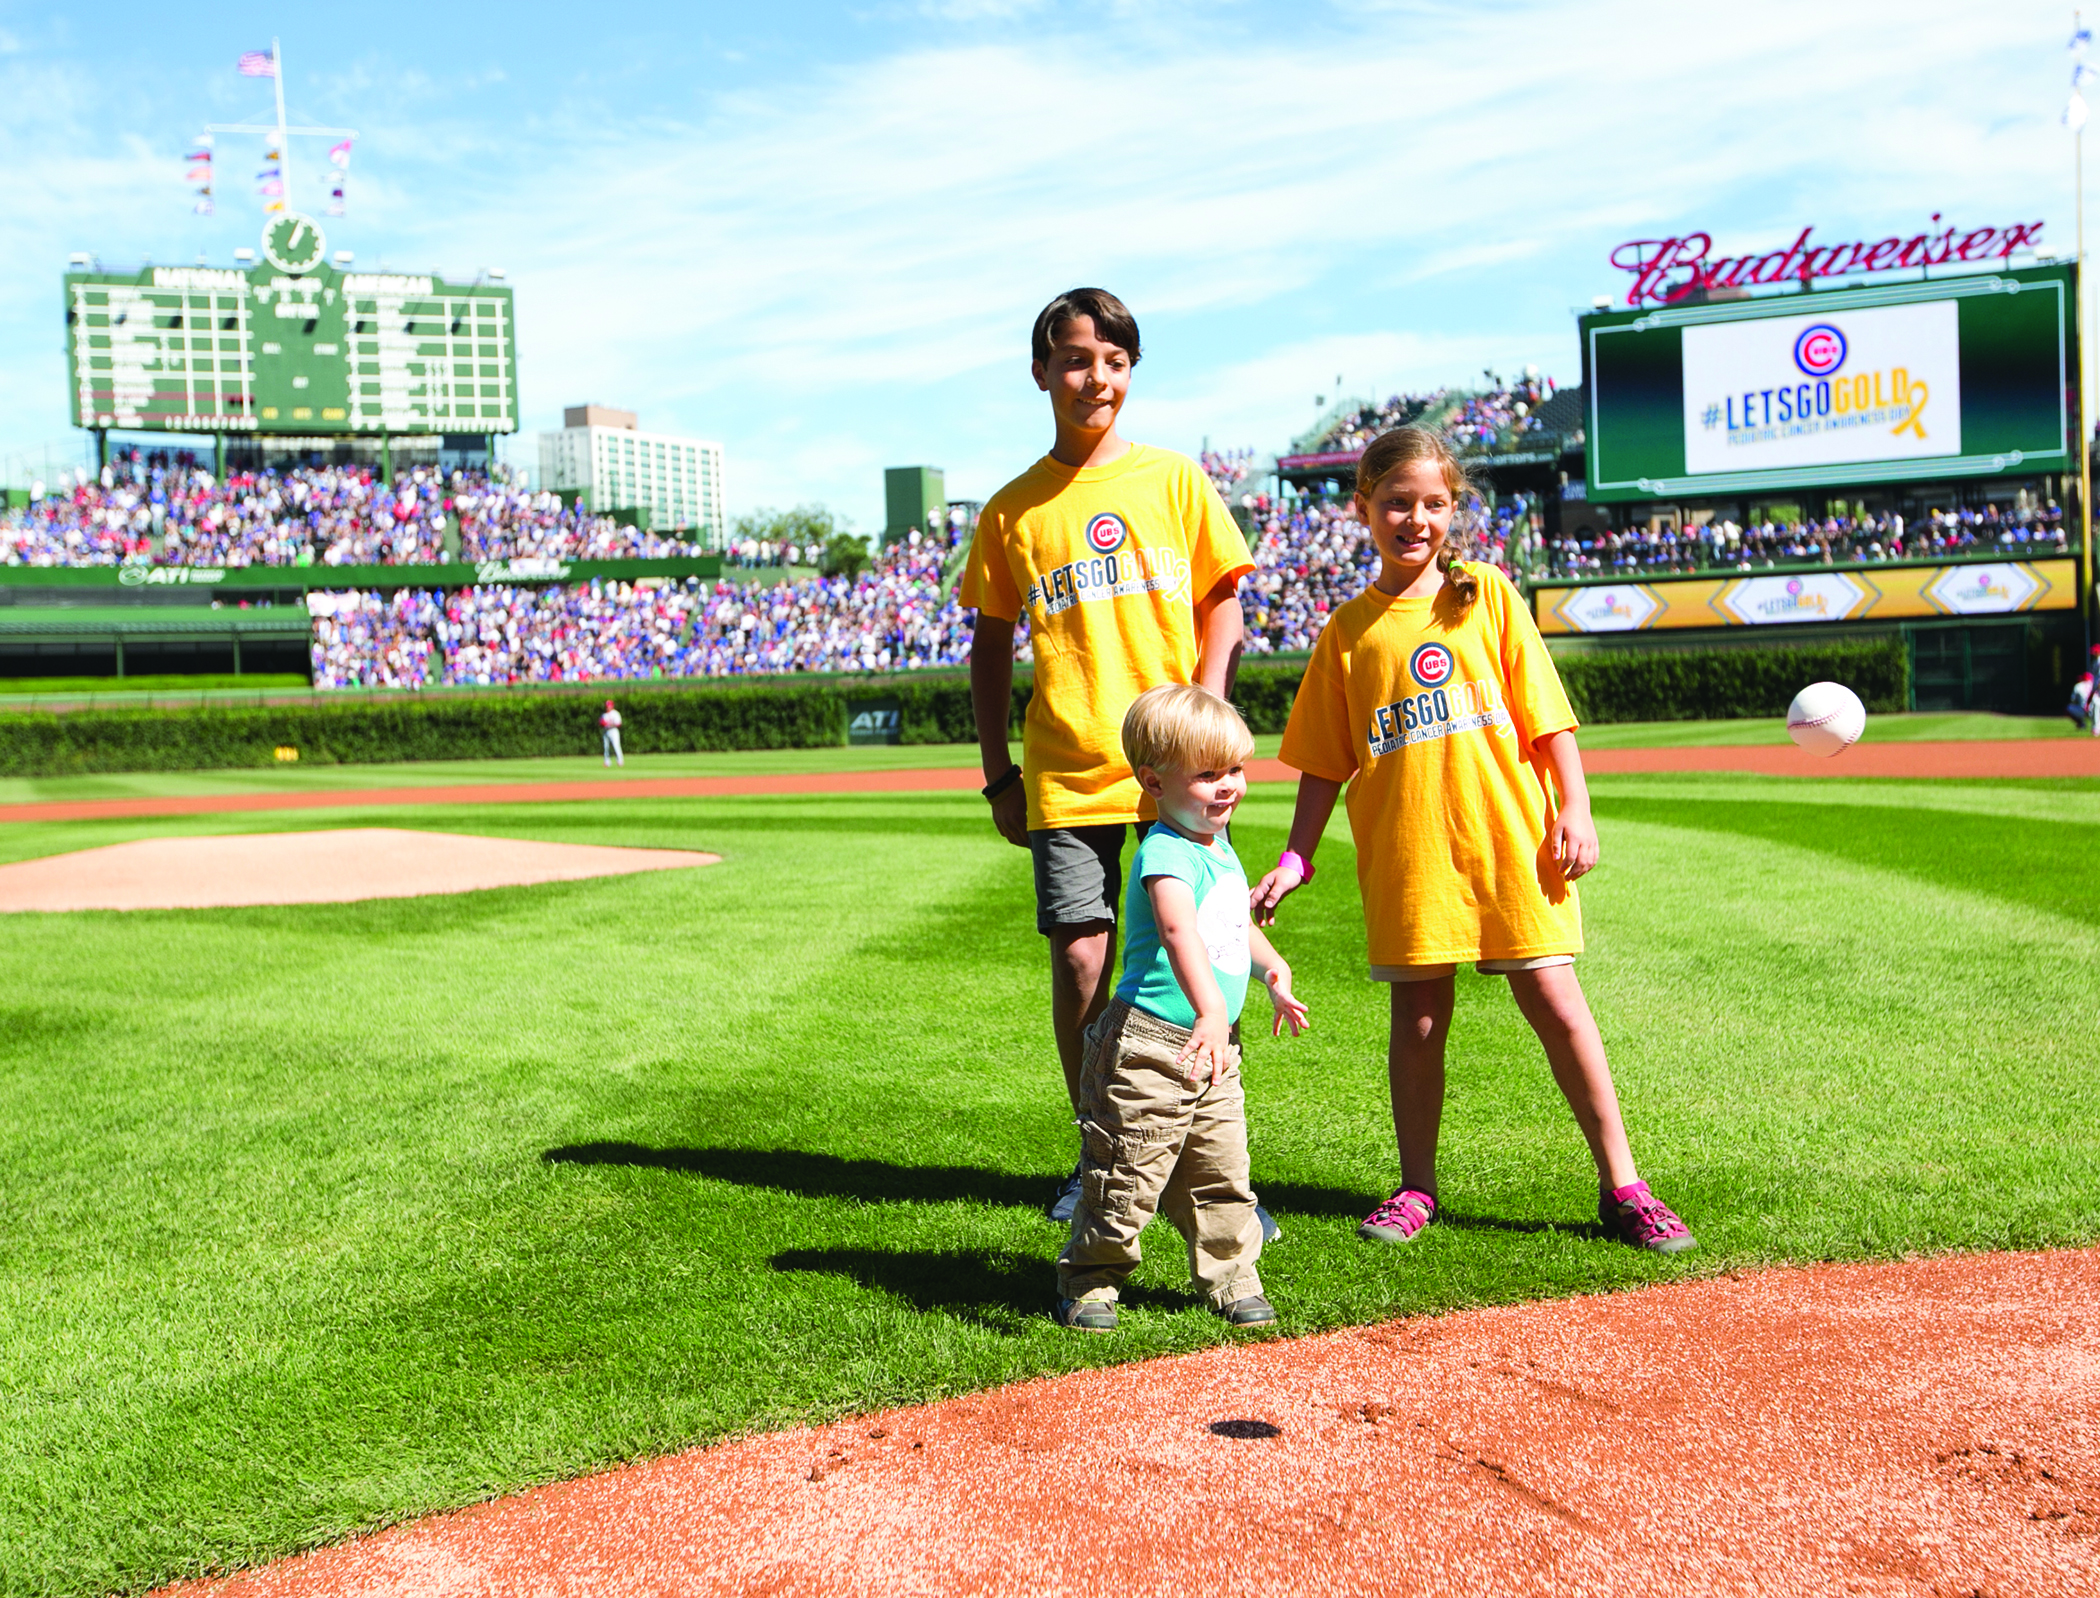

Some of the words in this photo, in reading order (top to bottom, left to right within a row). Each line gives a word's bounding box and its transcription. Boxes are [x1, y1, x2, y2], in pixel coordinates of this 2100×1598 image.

[1611, 213, 2045, 306] Budweiser
[1701, 367, 1909, 430] #LETSGOGOLD
[1782, 419, 1820, 437] CANCER
[1824, 410, 1886, 430] AWARENESS
[1092, 519, 1120, 547] CUBS
[1027, 547, 1176, 608] #LETSGOGOLD
[1113, 580, 1160, 597] AWARENESS
[1417, 649, 1448, 681] CUBS
[850, 710, 898, 729] ATI
[1410, 725, 1444, 743] CANCER
